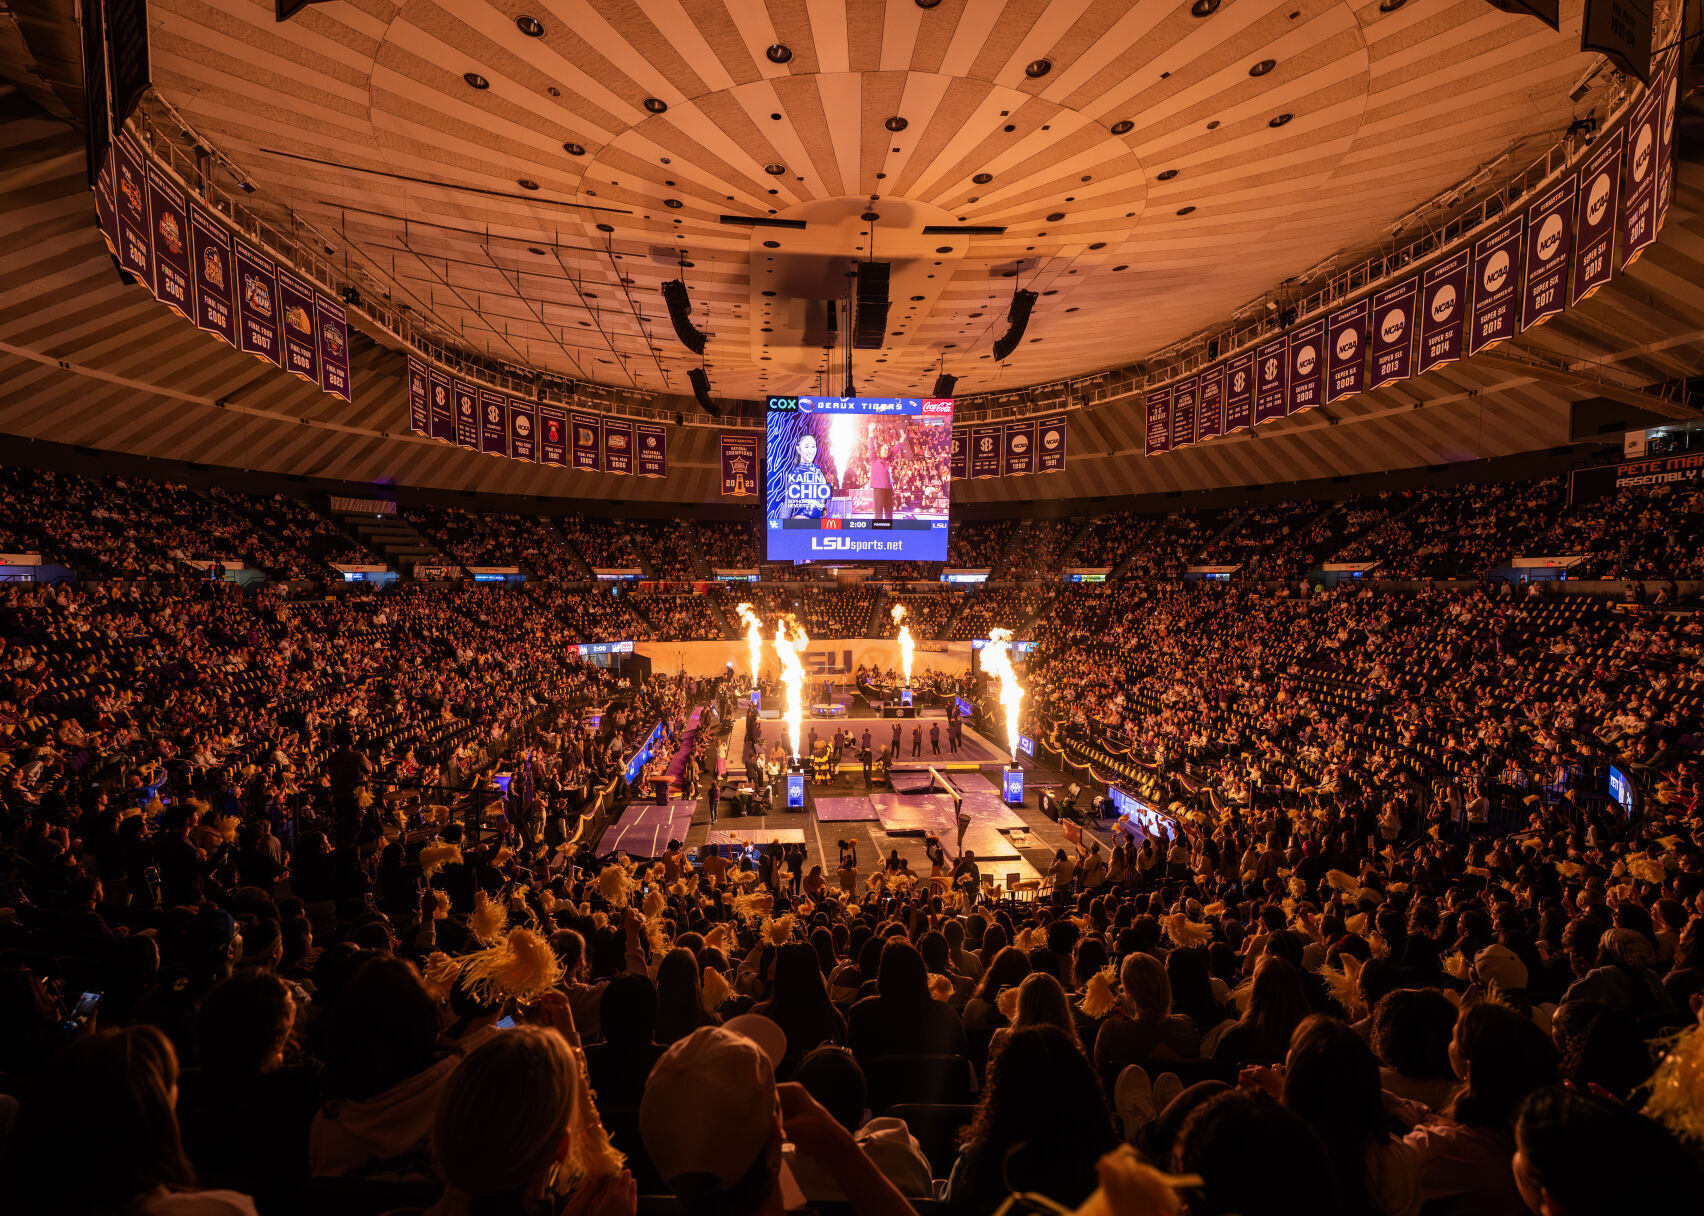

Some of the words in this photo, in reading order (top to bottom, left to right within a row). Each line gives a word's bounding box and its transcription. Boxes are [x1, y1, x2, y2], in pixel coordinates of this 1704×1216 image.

[1541, 190, 1564, 212] GYMNASTICS
[1589, 192, 1608, 218] NCAA
[1630, 216, 1645, 244] 2019
[1486, 229, 1510, 248] GYMNASTICS
[1540, 230, 1561, 253] NCAA
[1584, 248, 1598, 266] SUPER
[1598, 241, 1607, 254] SIX
[1435, 260, 1457, 276] GYMNASTICS
[1486, 265, 1507, 286] NCAA
[1585, 257, 1602, 281] 2018
[166, 278, 183, 302] 2005
[1533, 281, 1548, 296] SUPER
[1549, 274, 1559, 288] SIX
[204, 296, 216, 308] FINAL
[1434, 299, 1454, 315] NCAA
[1536, 288, 1554, 310] 2017
[208, 307, 226, 328] 2006
[1480, 312, 1497, 324] SUPER
[1498, 305, 1506, 315] SIX
[248, 320, 260, 334] FINAL
[1384, 321, 1404, 337] NCAA
[1483, 318, 1502, 336] 2016
[252, 332, 270, 350] 2007
[1429, 335, 1444, 346] SUPER
[1445, 330, 1454, 339] SIX
[1339, 341, 1356, 354] NCAA
[1430, 340, 1450, 358] 2014
[293, 353, 310, 369] 2008
[1299, 358, 1314, 369] NCAA
[1379, 354, 1393, 364] SUPER
[1395, 351, 1403, 359] SIX
[326, 364, 336, 374] FINAL
[1265, 358, 1277, 380] SEC
[1335, 371, 1348, 380] SUPER
[1381, 360, 1399, 375] 2013
[330, 374, 343, 388] 2023
[1234, 371, 1245, 392] SEC
[1296, 384, 1307, 393] SUPER
[1337, 376, 1354, 390] 2009
[770, 398, 797, 409] COX
[1297, 390, 1312, 403] 2008
[923, 402, 952, 412] Coca-Cola
[980, 437, 993, 452] SEC
[1617, 461, 1660, 476] PETE
[788, 474, 822, 482] KAILIN
[1616, 470, 1696, 488] ASSEMBLY
[788, 485, 830, 498] CHIO
[812, 537, 903, 552] LSUsports.net
[800, 651, 852, 675] SU
